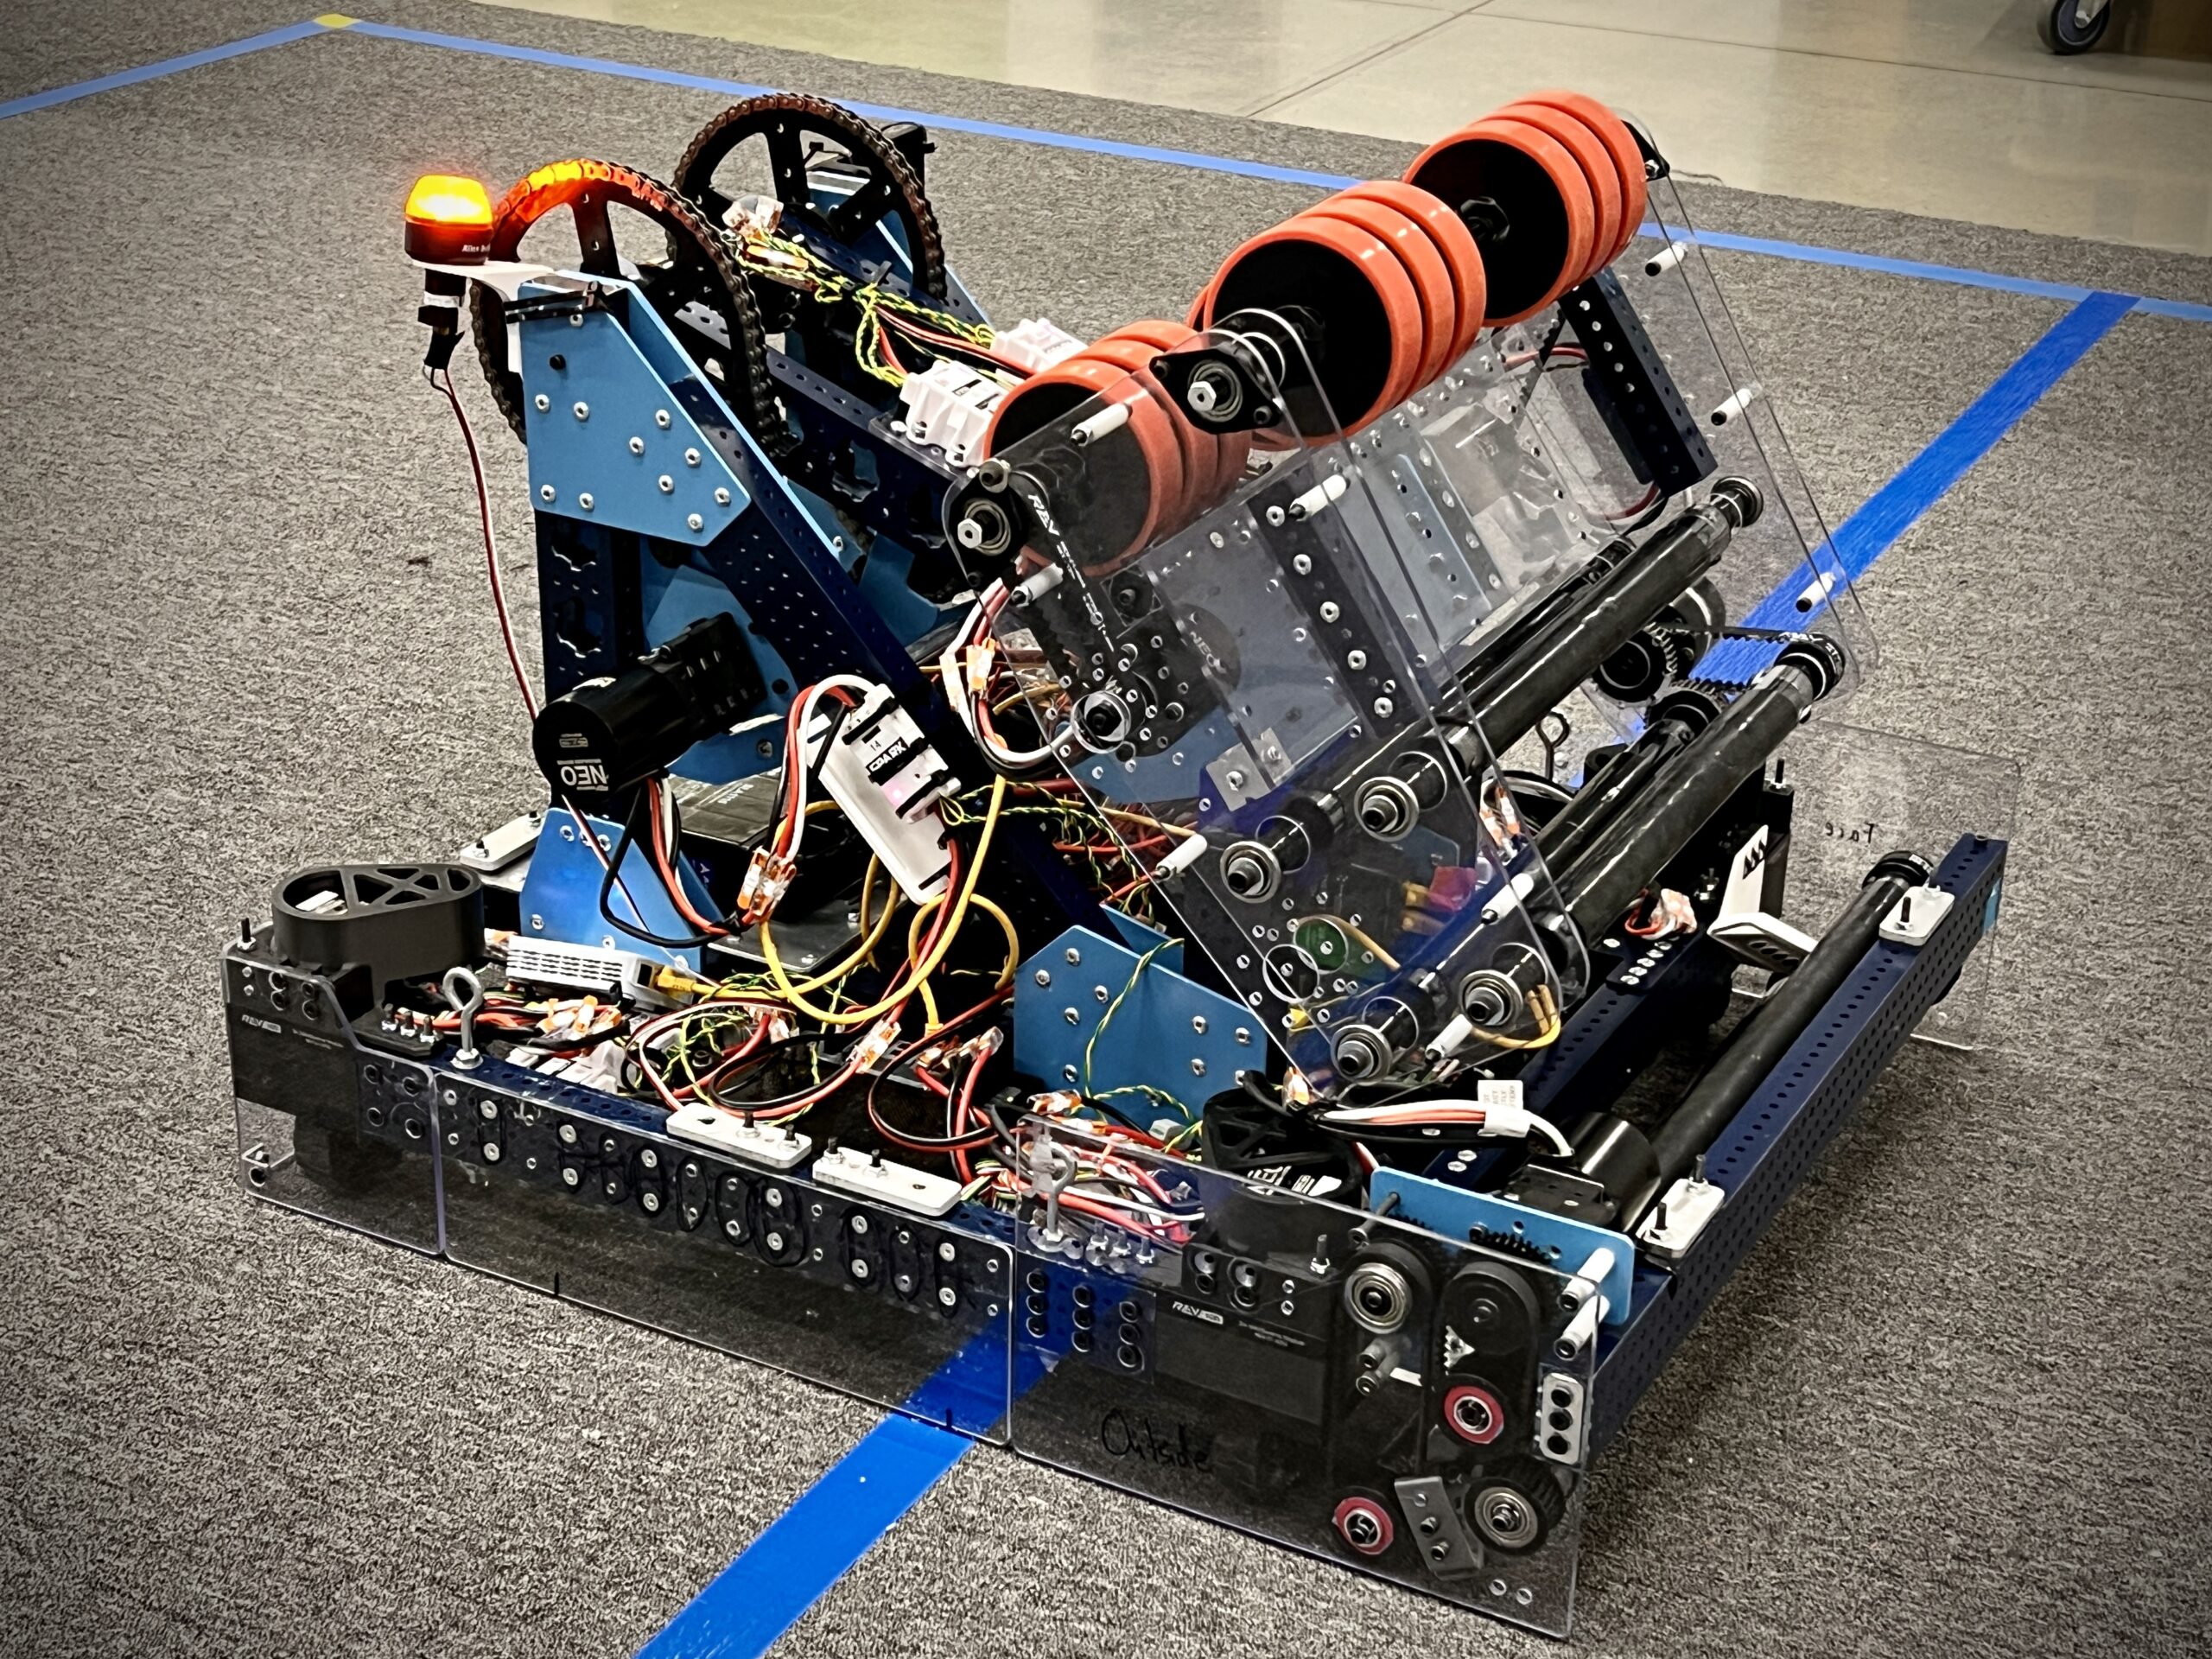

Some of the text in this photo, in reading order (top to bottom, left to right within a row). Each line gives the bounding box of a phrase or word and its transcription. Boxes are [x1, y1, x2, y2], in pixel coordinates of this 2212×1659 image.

[1028, 494, 1060, 537] REV
[560, 765, 607, 786] NEO
[1172, 1300, 1199, 1316] REV
[1102, 1408, 1212, 1472] Outside
